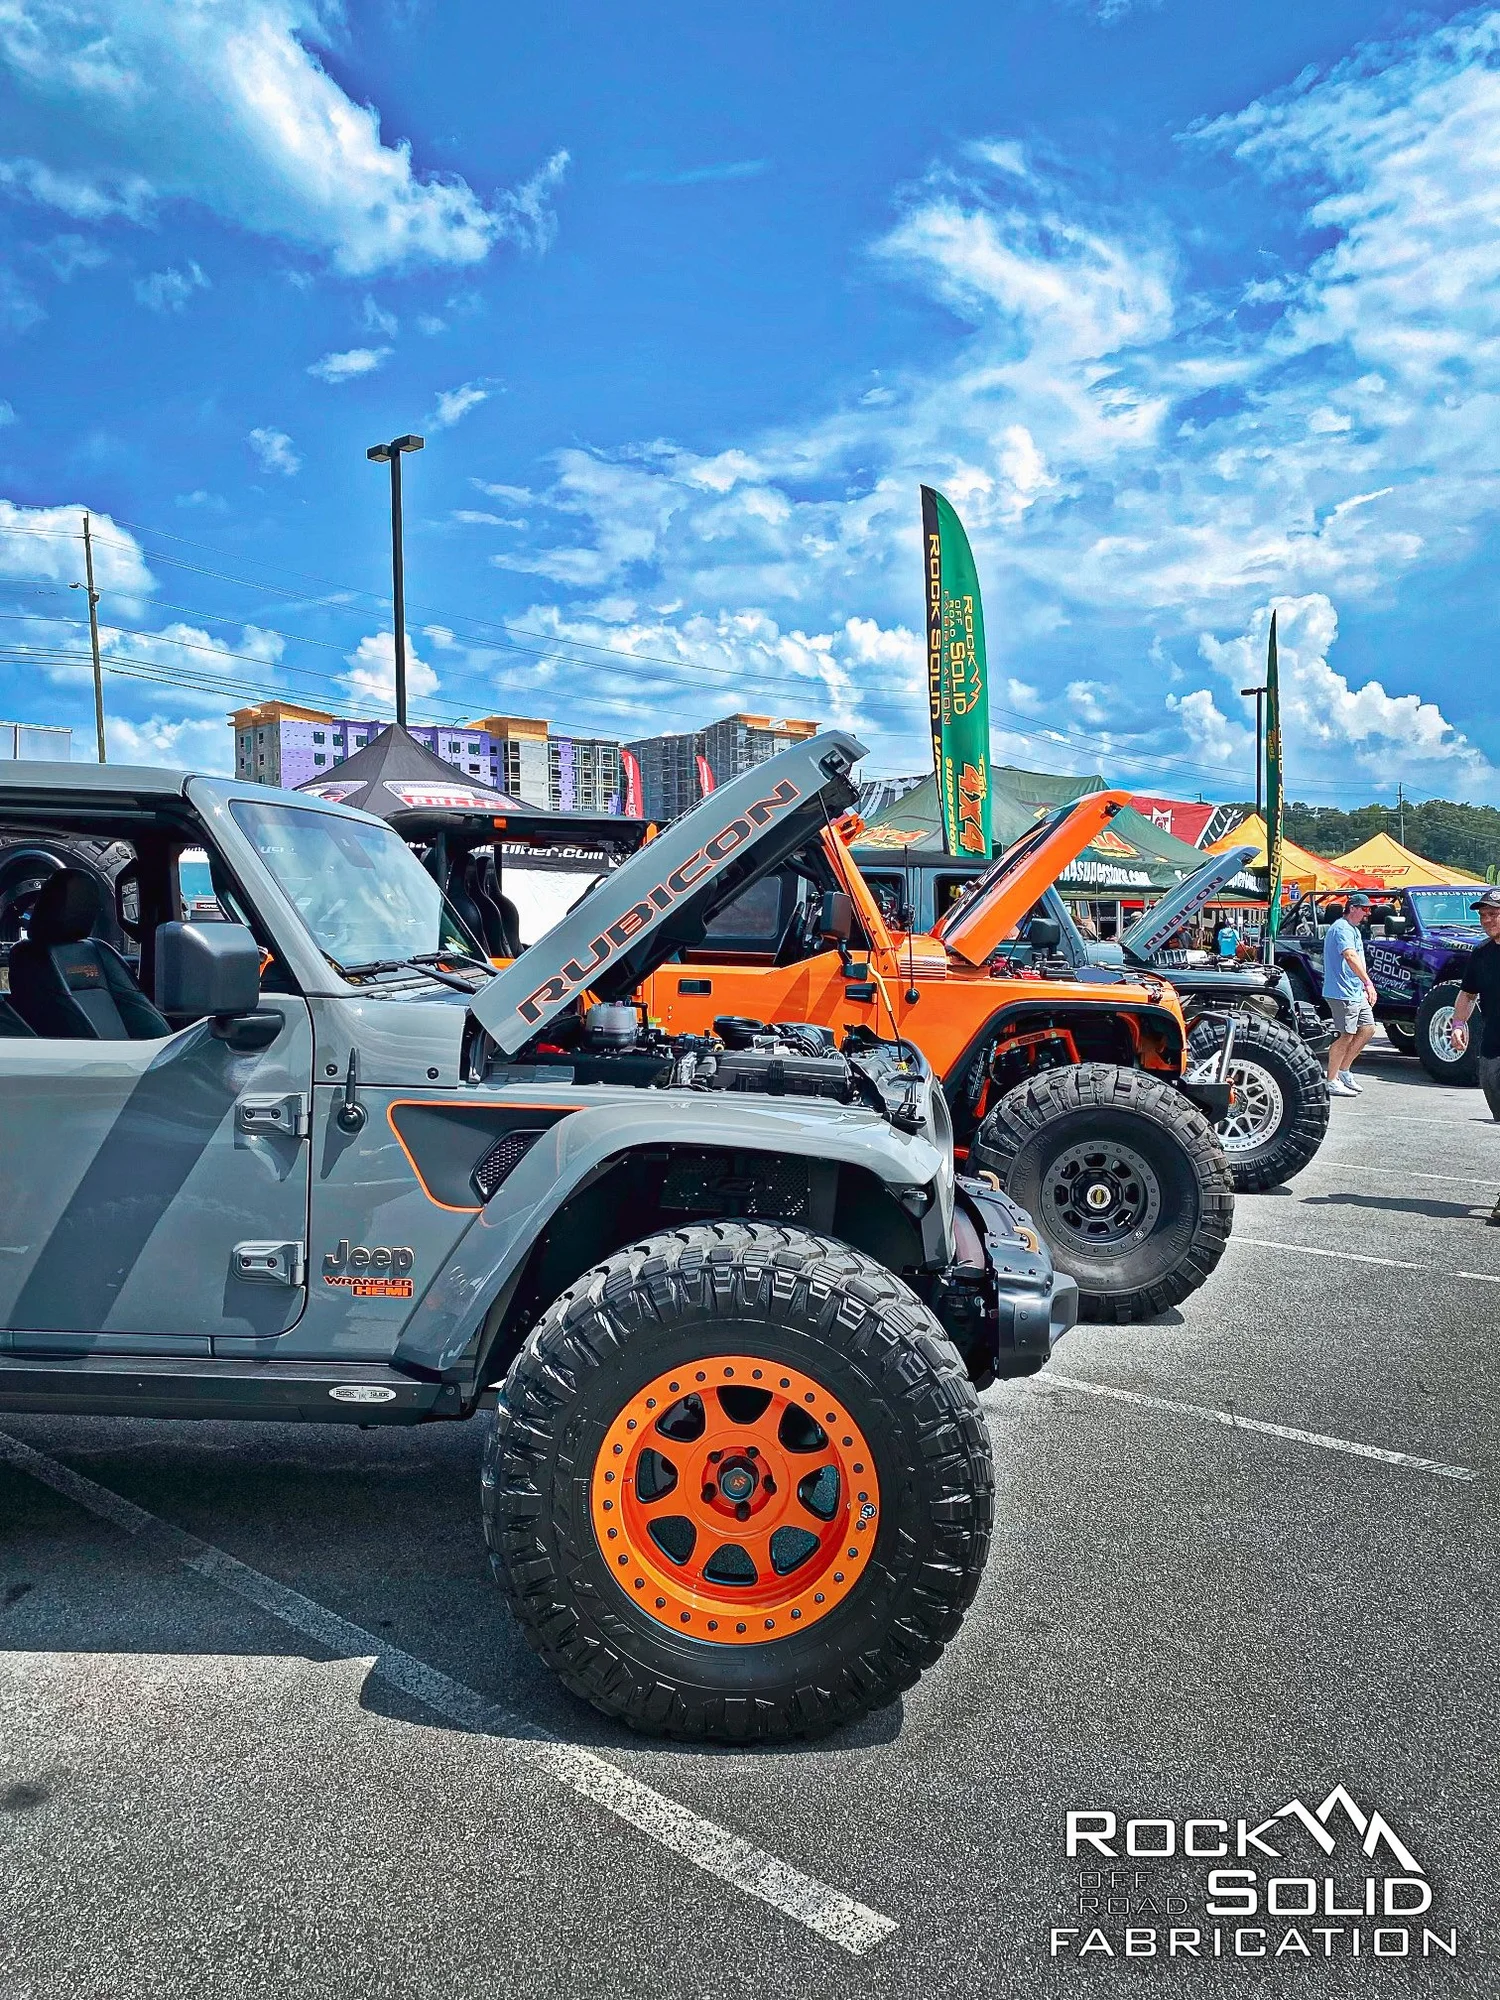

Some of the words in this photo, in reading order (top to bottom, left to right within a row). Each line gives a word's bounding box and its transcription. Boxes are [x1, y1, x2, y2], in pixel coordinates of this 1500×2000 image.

[929, 534, 941, 622] ROCK
[954, 600, 963, 625] OFF
[963, 595, 975, 667] ROCK
[930, 629, 942, 719] SOLID
[950, 642, 967, 715] SOLID
[517, 779, 801, 1025] RUBICON
[1144, 876, 1223, 950] RUBICON
[1367, 944, 1401, 966] ROCK
[1373, 959, 1411, 981] SOLID
[324, 1239, 415, 1273] Jeep
[324, 1276, 412, 1286] WRANGLER
[355, 1285, 409, 1296] HEMI
